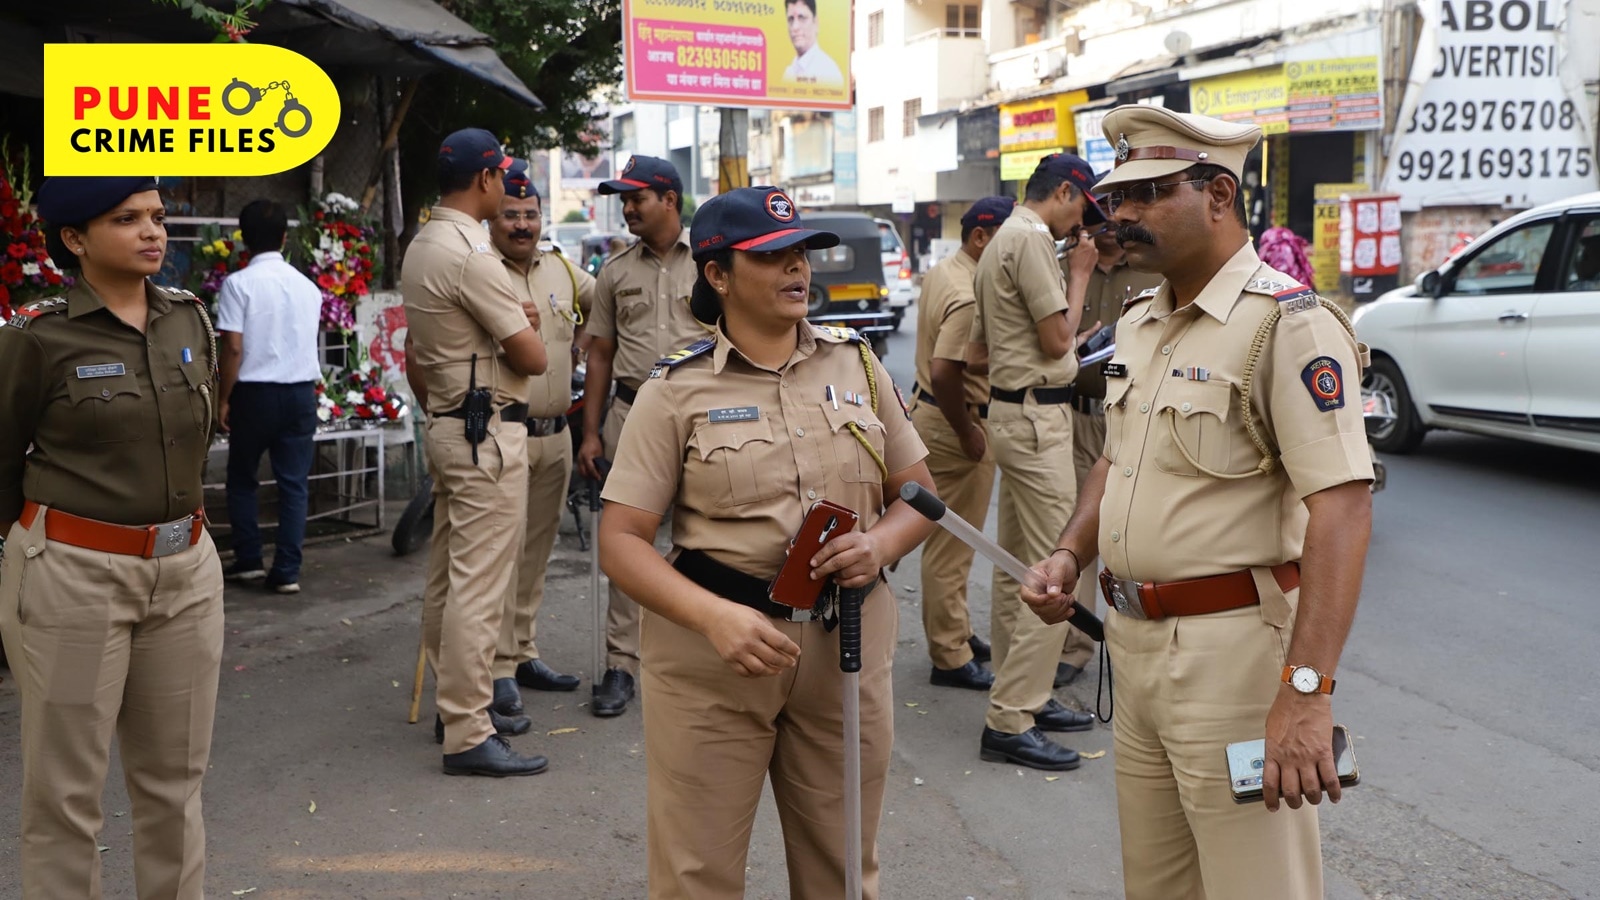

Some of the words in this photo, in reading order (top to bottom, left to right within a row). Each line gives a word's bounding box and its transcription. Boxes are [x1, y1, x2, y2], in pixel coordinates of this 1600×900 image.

[677, 46, 762, 72] 8239305661
[1432, 45, 1560, 78] DVERTISI
[1398, 147, 1591, 182] 9921693175
[1317, 206, 1340, 219] XE
